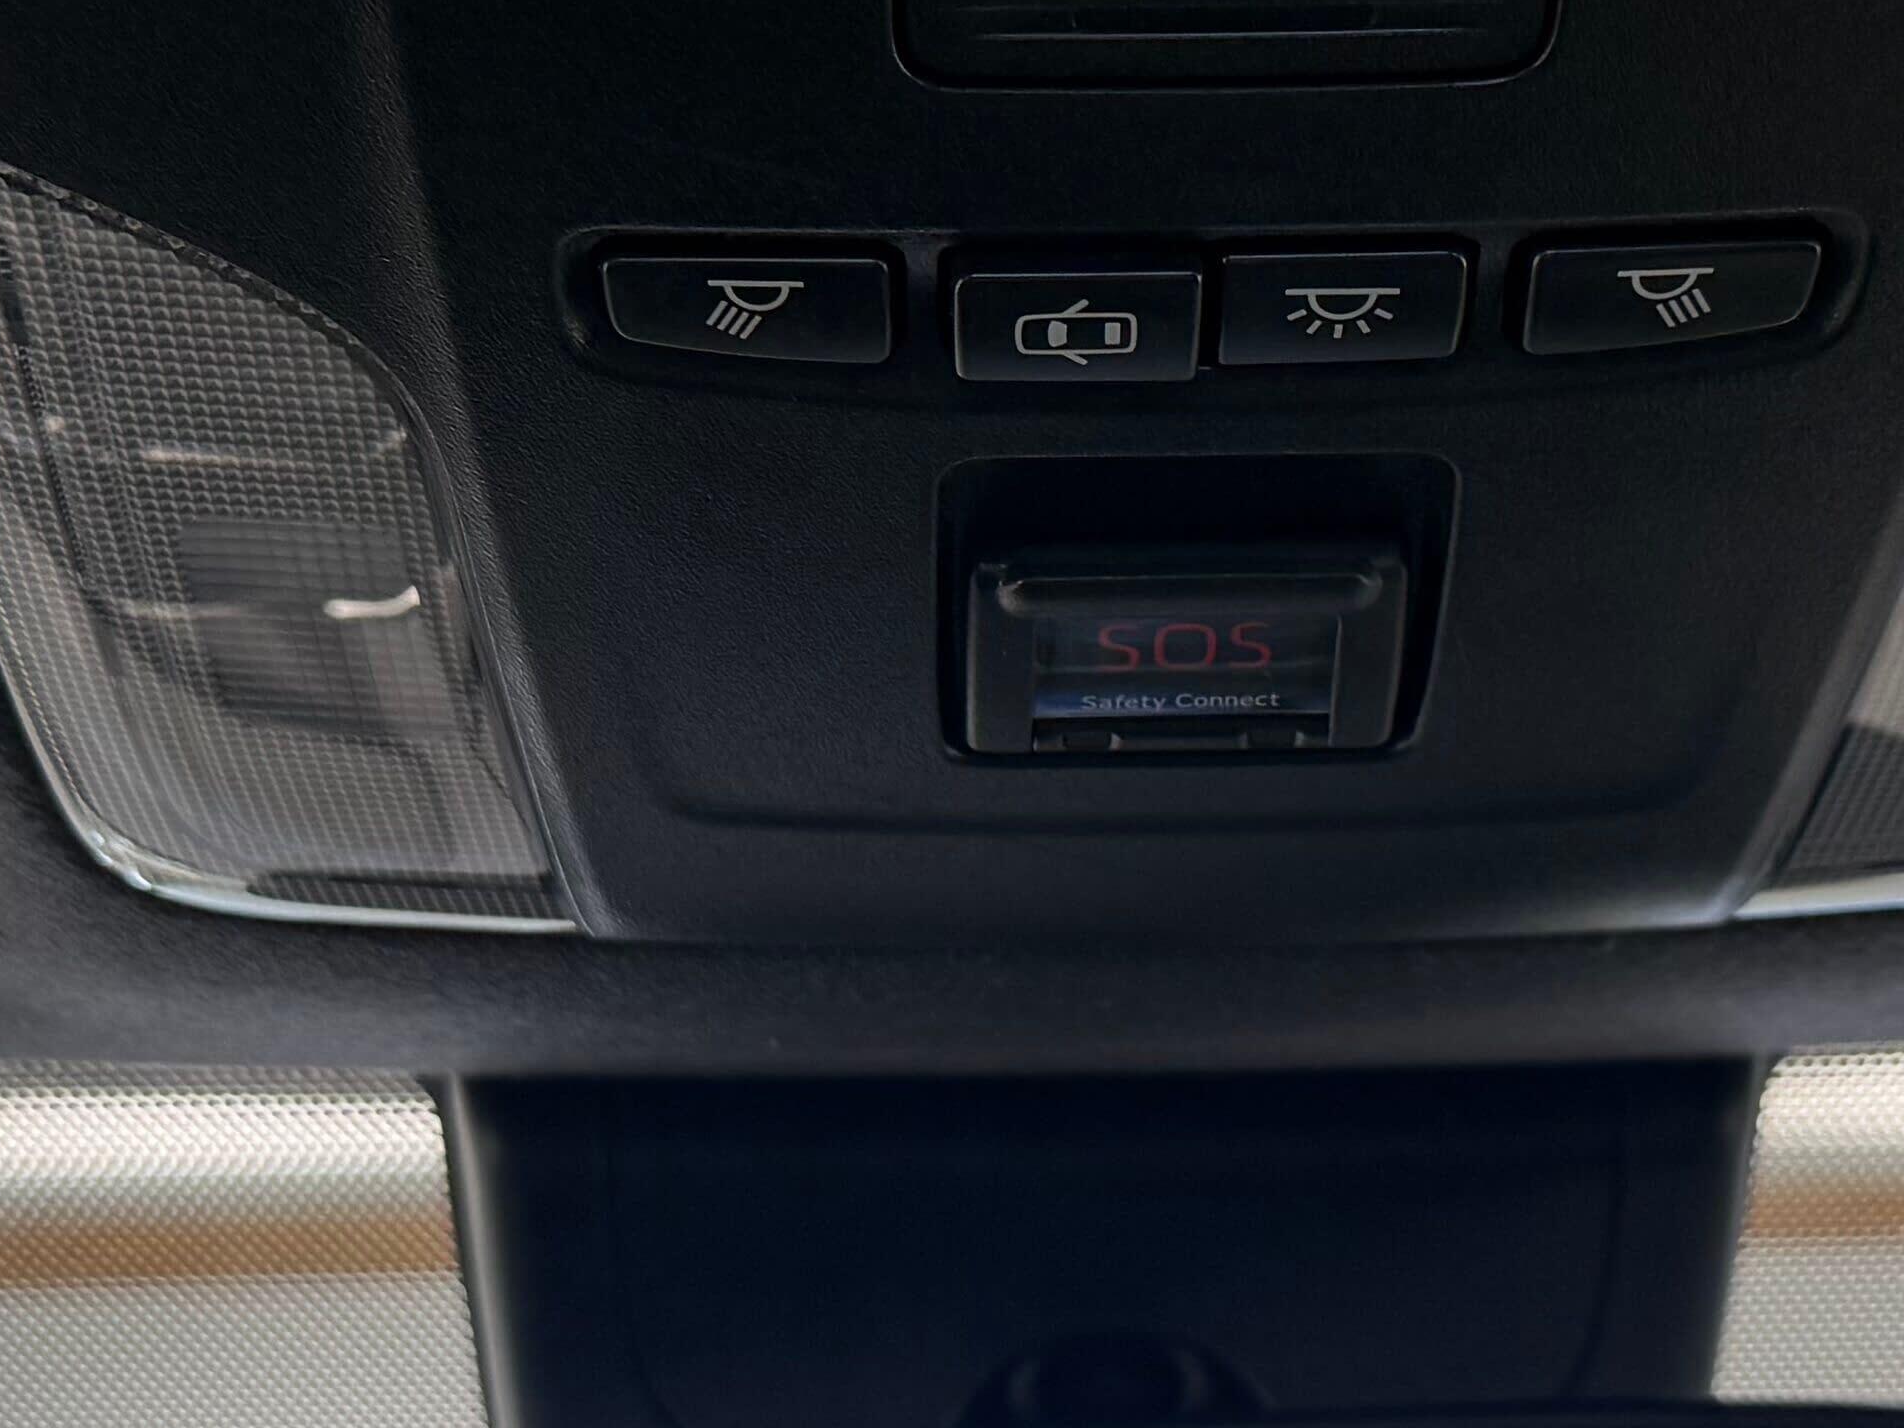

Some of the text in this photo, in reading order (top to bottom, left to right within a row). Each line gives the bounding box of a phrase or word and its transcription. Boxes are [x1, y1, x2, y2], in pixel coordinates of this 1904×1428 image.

[1097, 622, 1273, 673] SOS
[1080, 691, 1281, 712] Safety Connect
